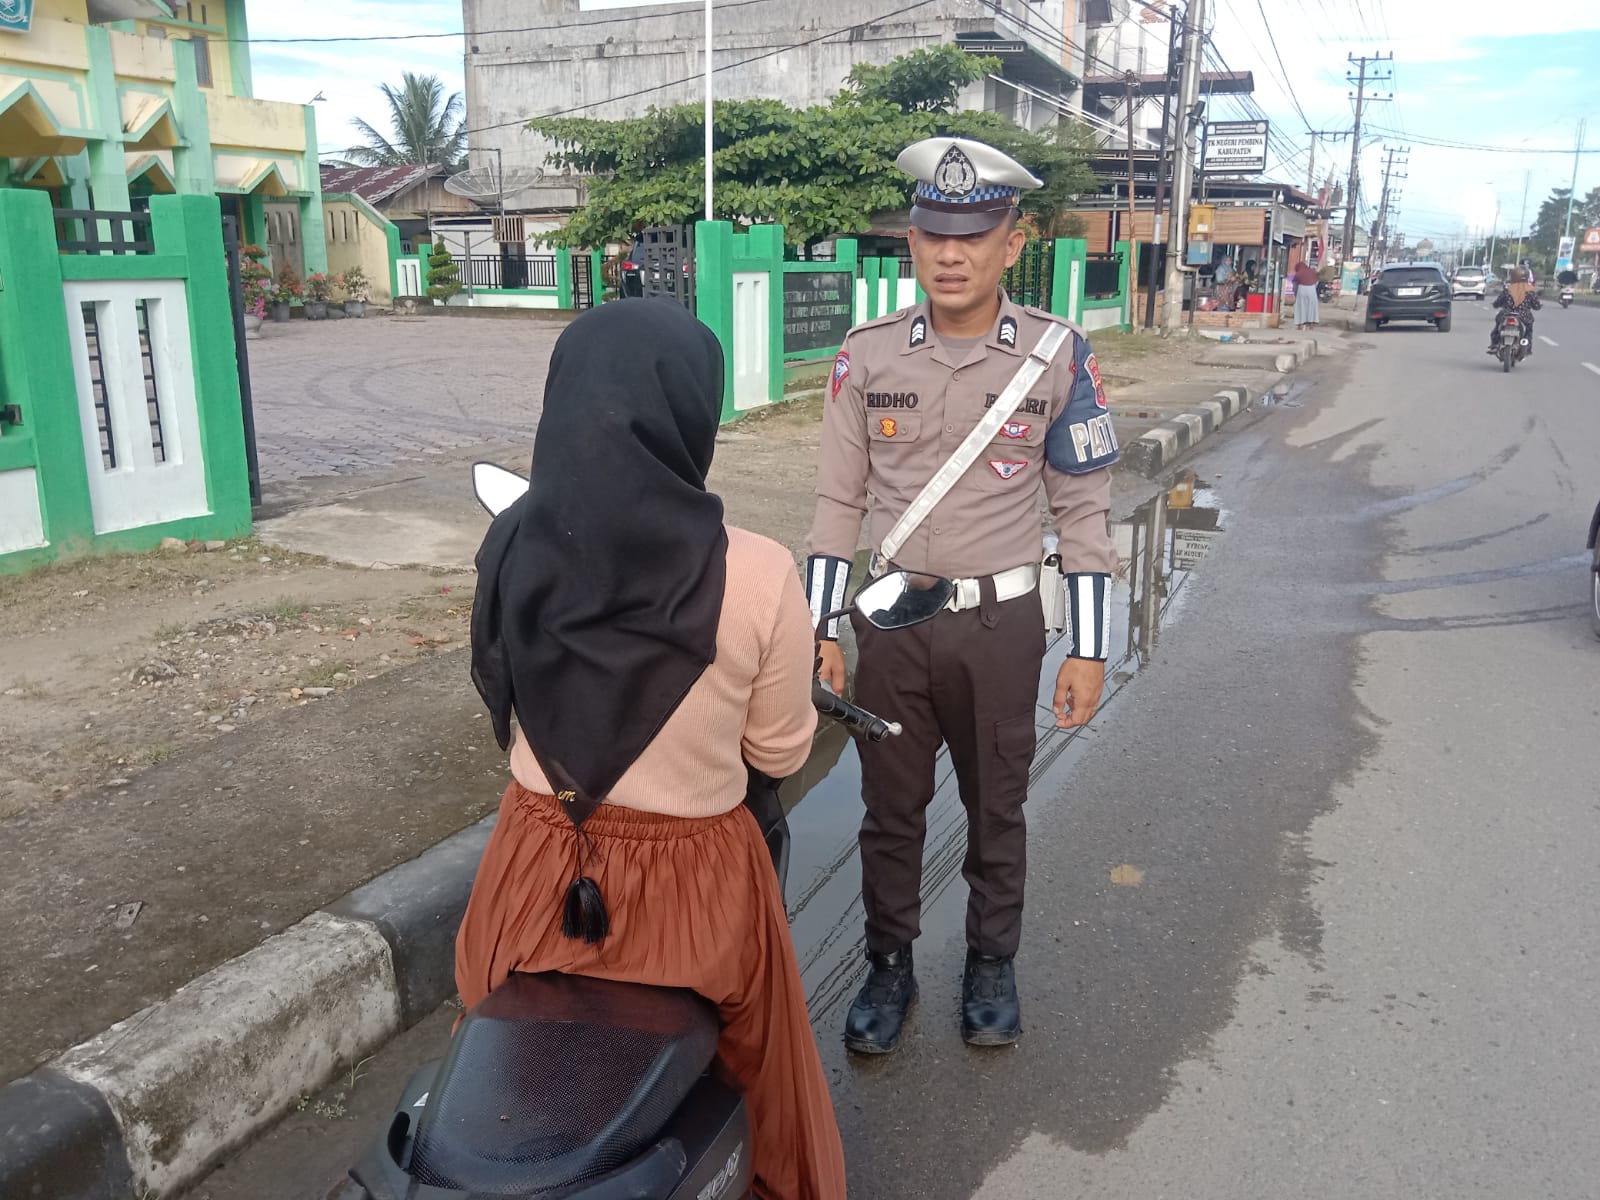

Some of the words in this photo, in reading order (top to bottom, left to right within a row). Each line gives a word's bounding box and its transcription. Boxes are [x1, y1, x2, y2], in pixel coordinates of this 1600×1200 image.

[1208, 139, 1215, 147] TK
[1217, 138, 1237, 146] NEGERI
[1238, 138, 1263, 146] PEMBINA
[1218, 147, 1251, 155] KABUPATEN
[866, 392, 919, 409] RIDHO
